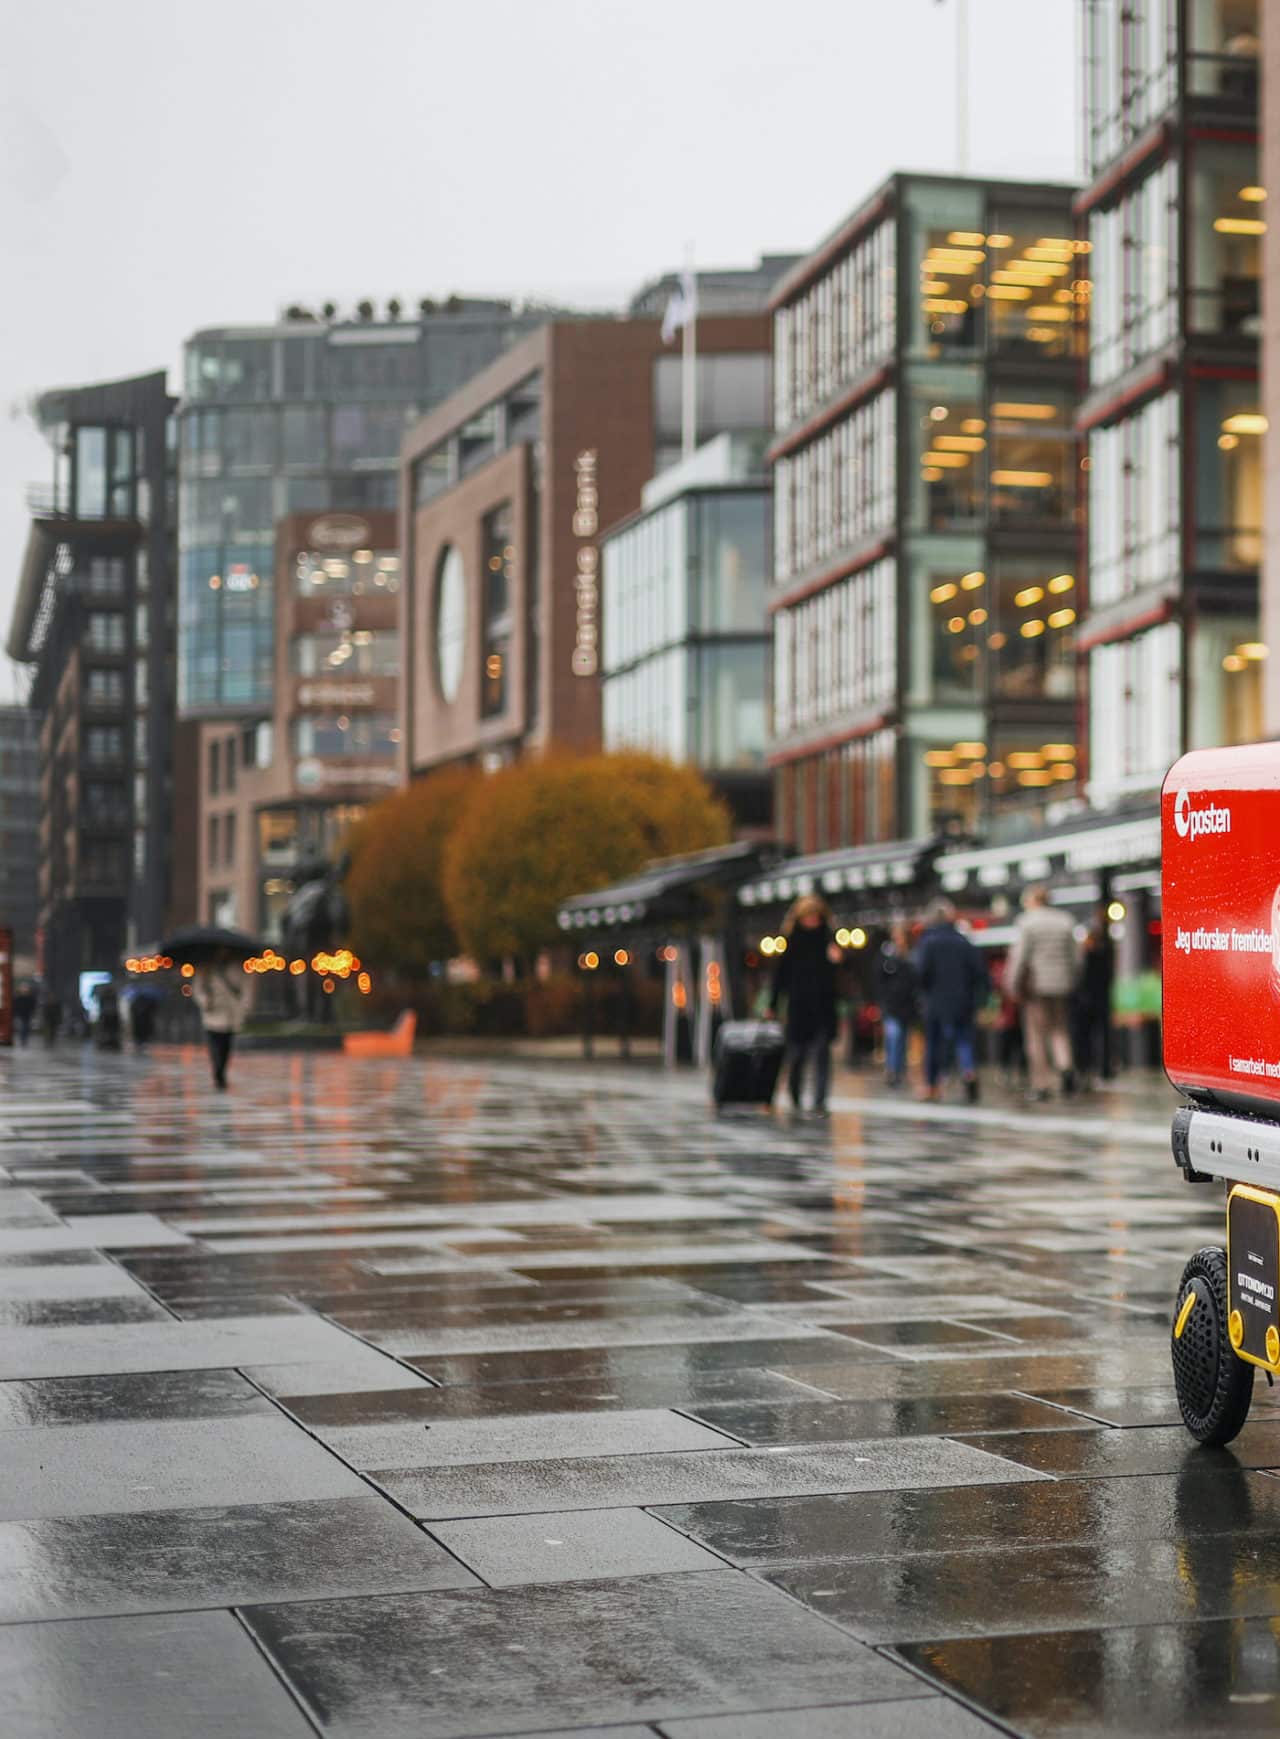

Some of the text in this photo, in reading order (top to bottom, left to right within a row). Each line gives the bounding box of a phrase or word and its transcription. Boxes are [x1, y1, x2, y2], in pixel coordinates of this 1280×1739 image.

[571, 449, 599, 676] Danske Bank
[1190, 802, 1231, 842] posten
[1175, 926, 1275, 954] Jeg utforsker fremtiden
[1265, 1061, 1280, 1078] med
